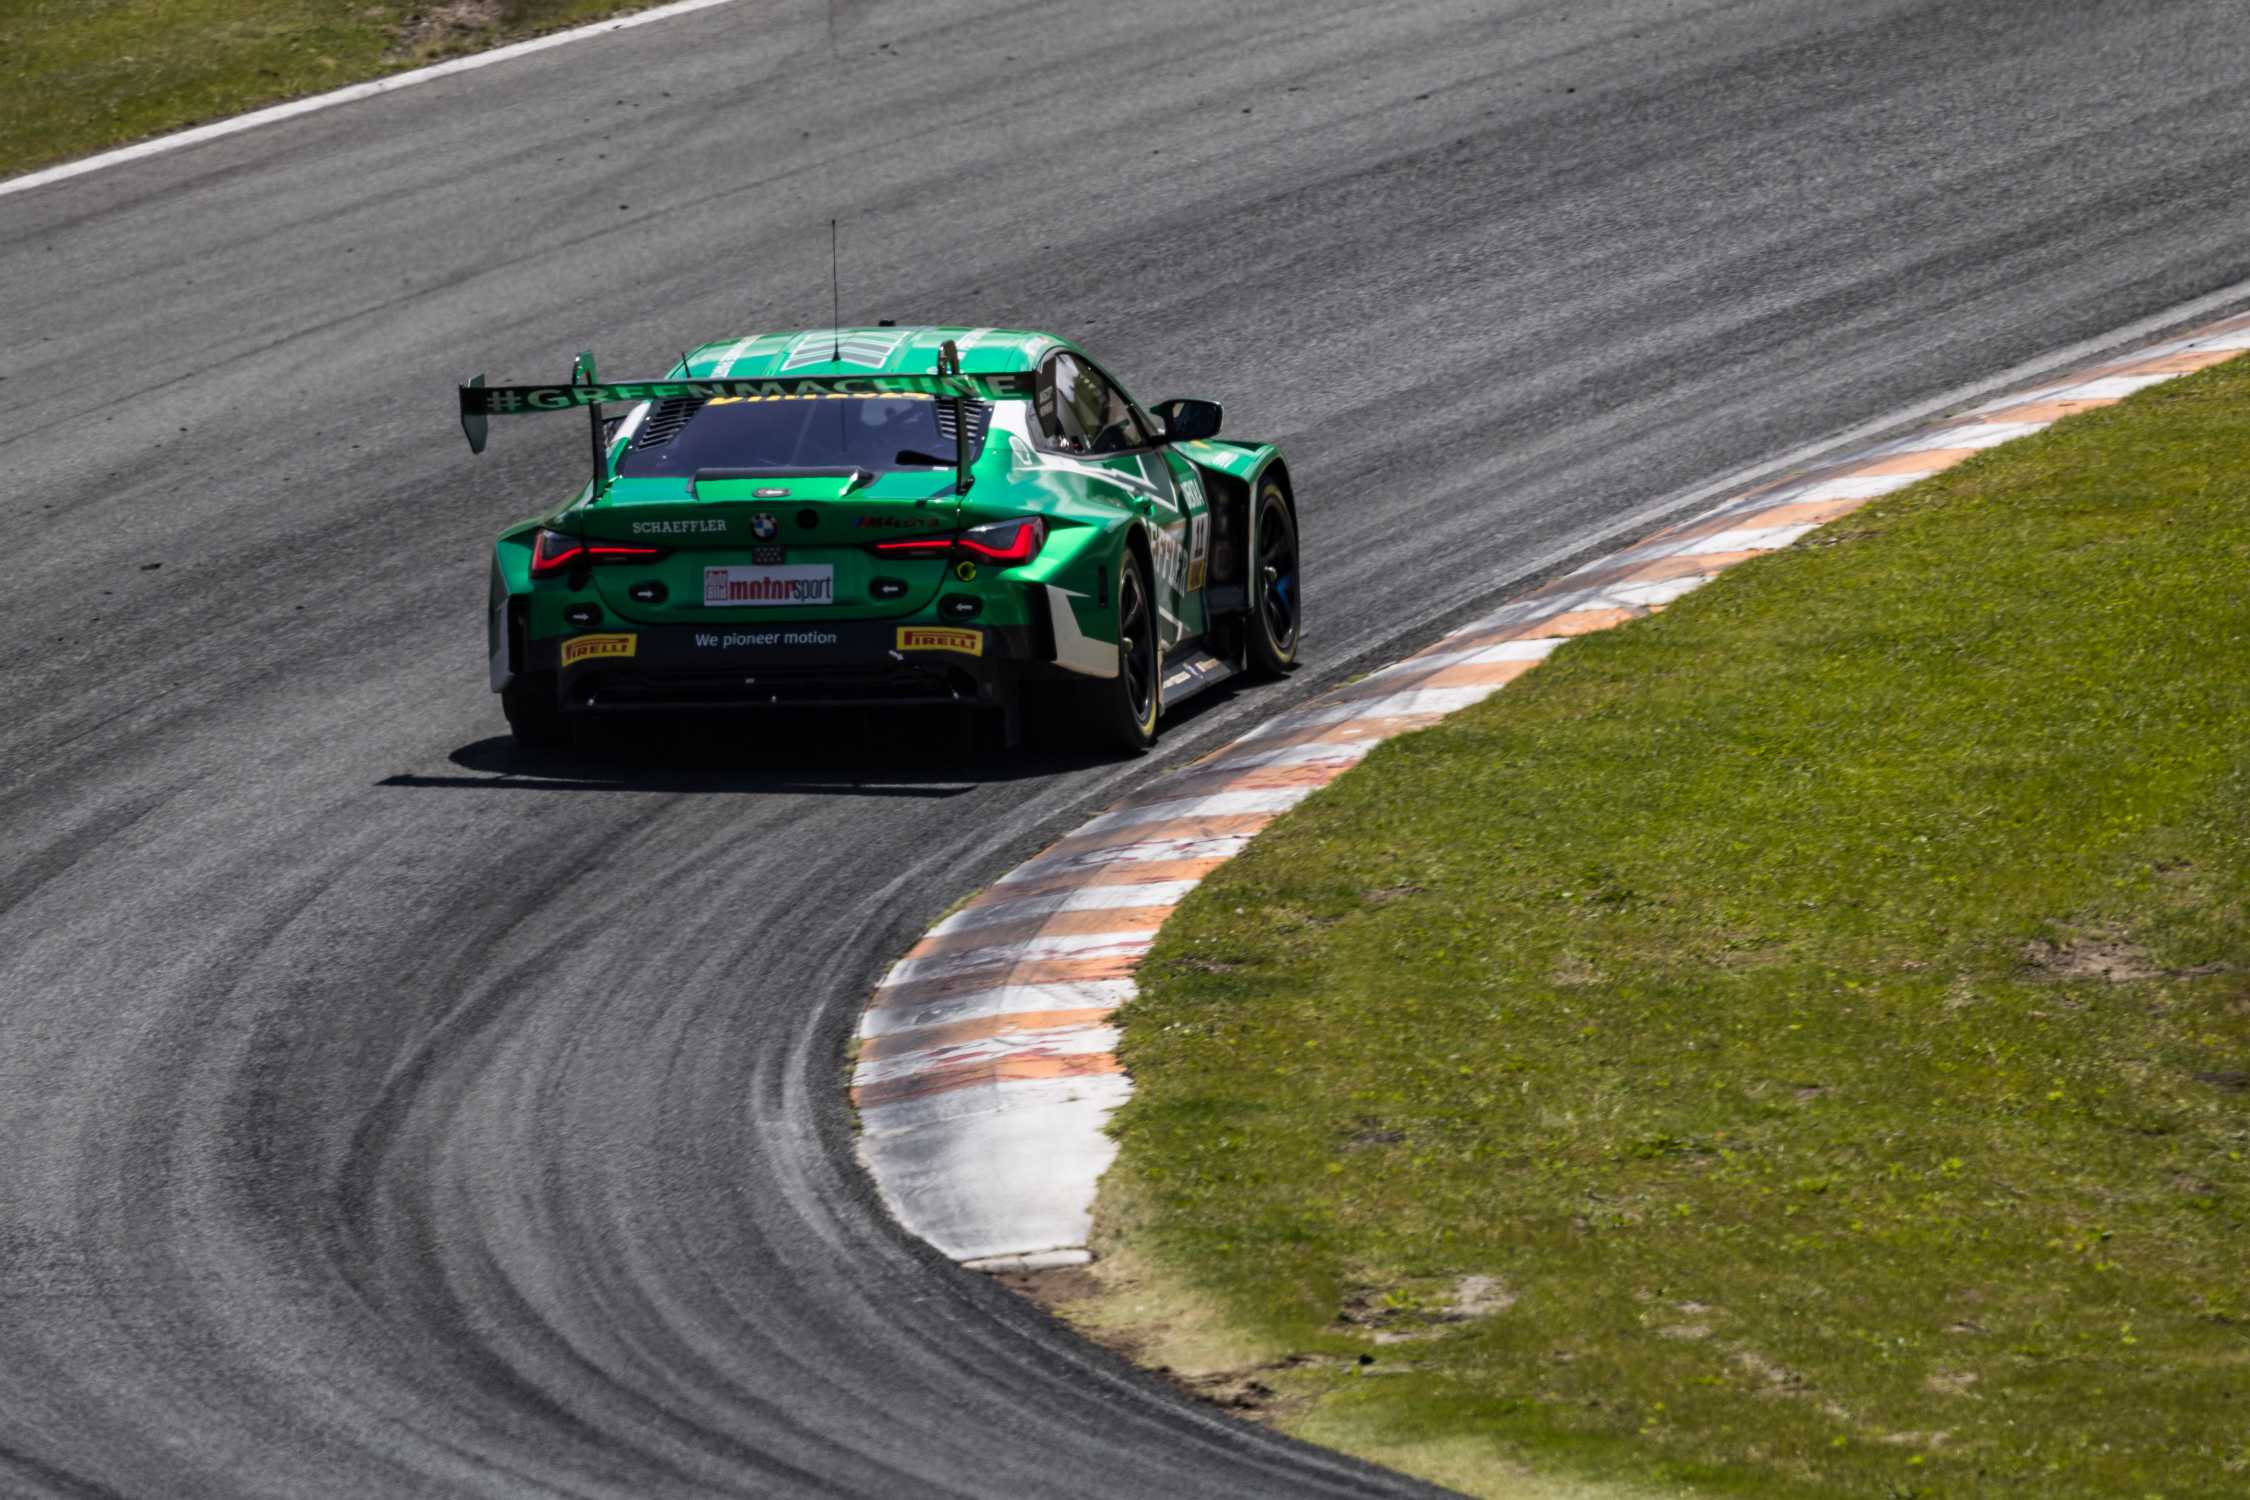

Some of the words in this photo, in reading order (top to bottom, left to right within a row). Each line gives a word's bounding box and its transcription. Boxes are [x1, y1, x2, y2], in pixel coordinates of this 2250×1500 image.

[487, 374, 1023, 412] #GREENMACHINE
[632, 519, 727, 534] SCHAEFFLER
[729, 576, 831, 602] motorsport
[565, 637, 632, 662] PIRELLI
[695, 633, 719, 647] We
[722, 631, 779, 648] pioneer
[784, 631, 837, 645] motion
[904, 631, 977, 651] PIRELLI
